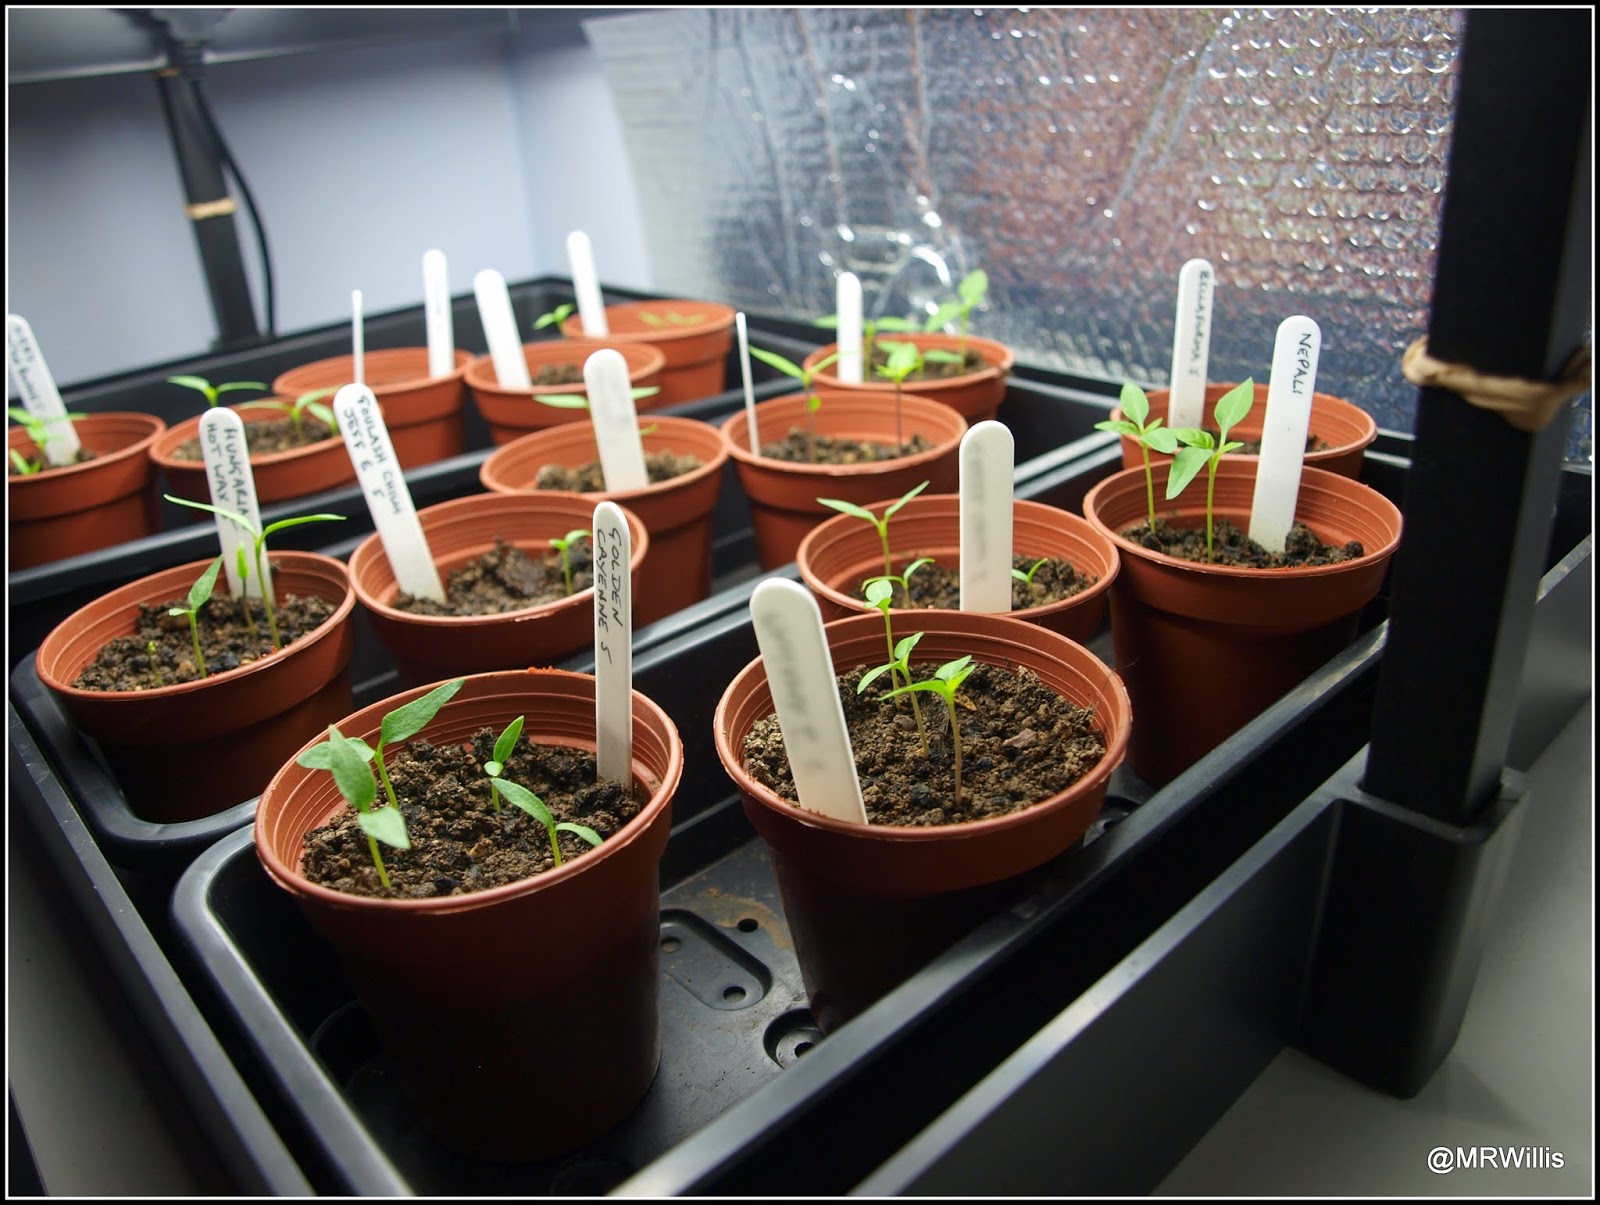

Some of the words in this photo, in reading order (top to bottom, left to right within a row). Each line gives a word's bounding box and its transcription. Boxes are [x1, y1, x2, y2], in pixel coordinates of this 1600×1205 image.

[1292, 332, 1312, 395] NEPALI
[206, 422, 221, 457] HOT
[357, 395, 387, 463] GOULASH
[213, 463, 228, 501] WAX
[223, 427, 249, 531] HUNGARIA
[595, 528, 609, 633] CAYENNE
[608, 527, 624, 627] GOLDEN
